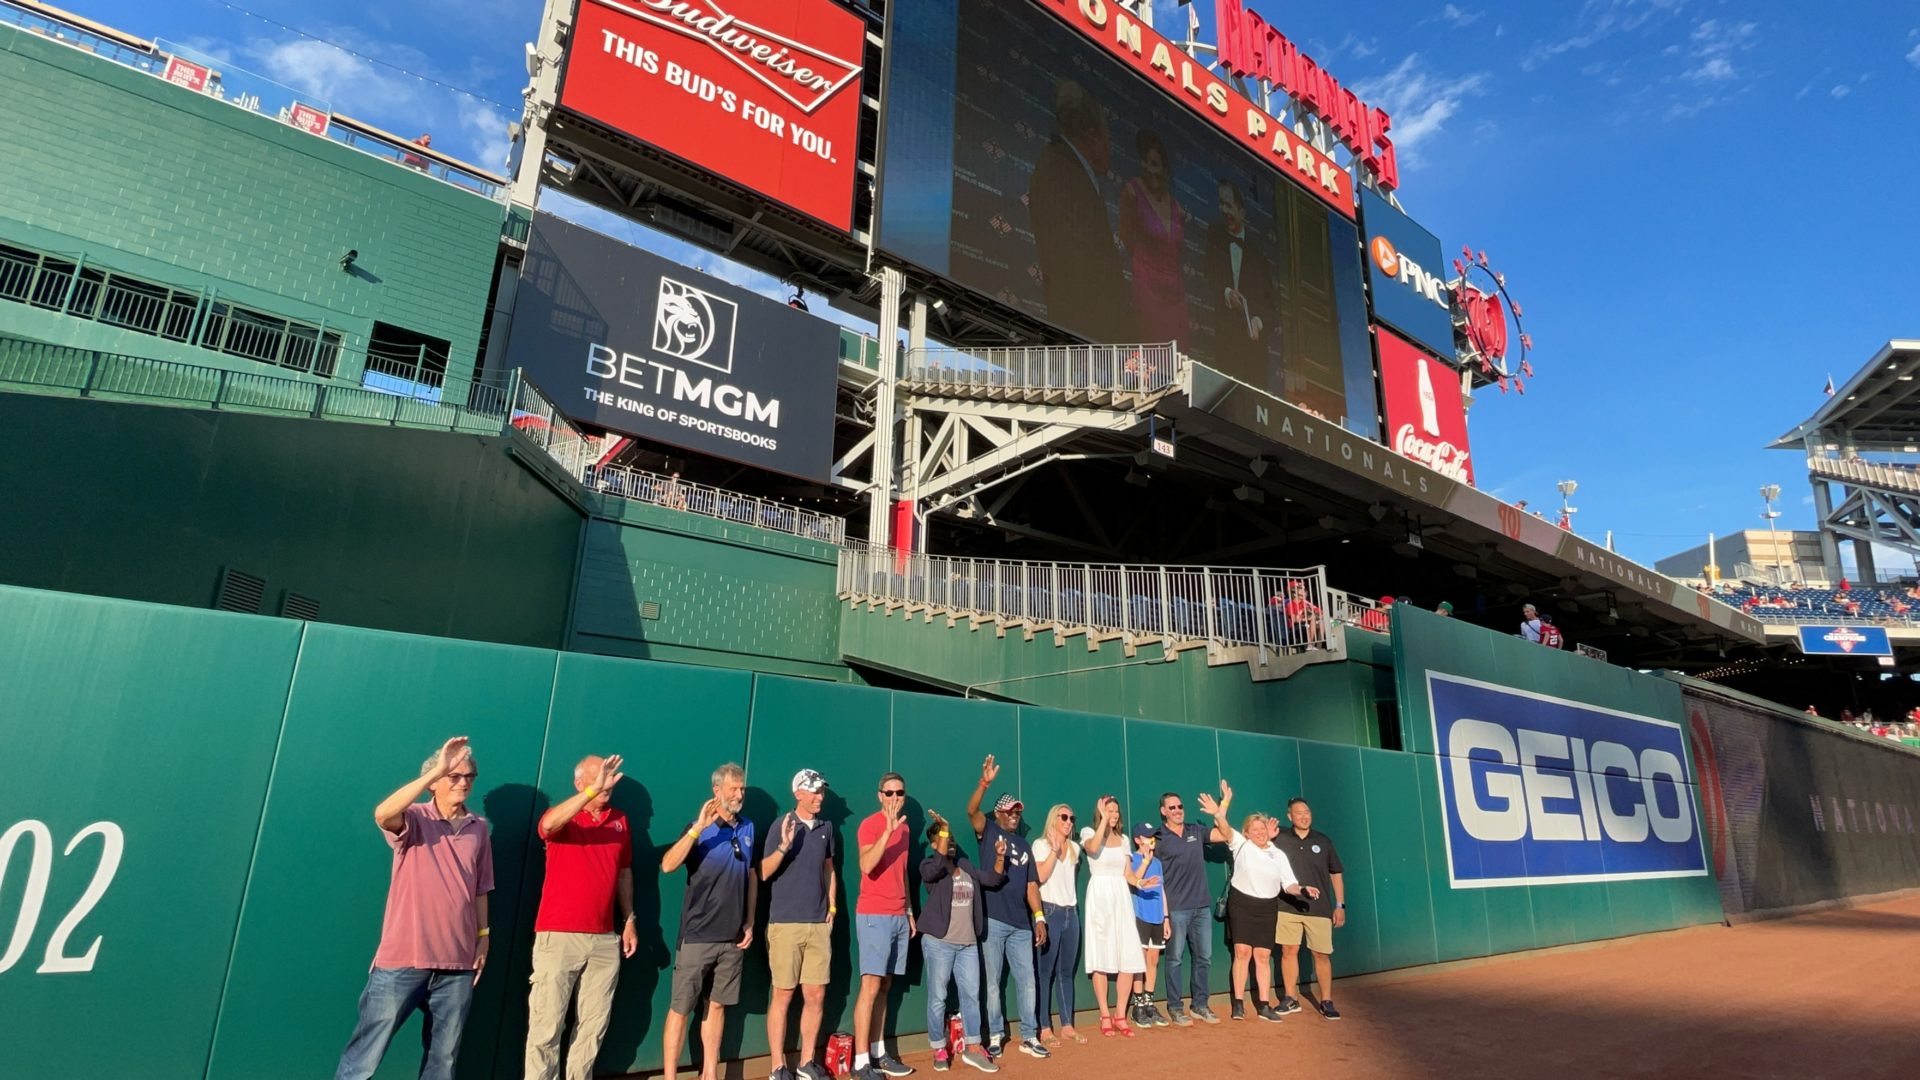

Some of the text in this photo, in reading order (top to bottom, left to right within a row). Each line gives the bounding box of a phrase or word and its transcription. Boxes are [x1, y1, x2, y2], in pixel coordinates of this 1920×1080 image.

[175, 63, 196, 76] THIS
[602, 29, 837, 164] THIS BUD'S FOR YOU.
[1247, 109, 1340, 195] PARK
[1397, 253, 1449, 309] PNC
[584, 387, 777, 450] THE KING OF SPORTSBOOKS
[586, 342, 779, 429] BETMGM
[1256, 404, 1428, 493] NATIONALS
[1577, 546, 1661, 594] NATIONALS
[1448, 719, 1693, 843] GEICO
[0, 819, 124, 974] 02
